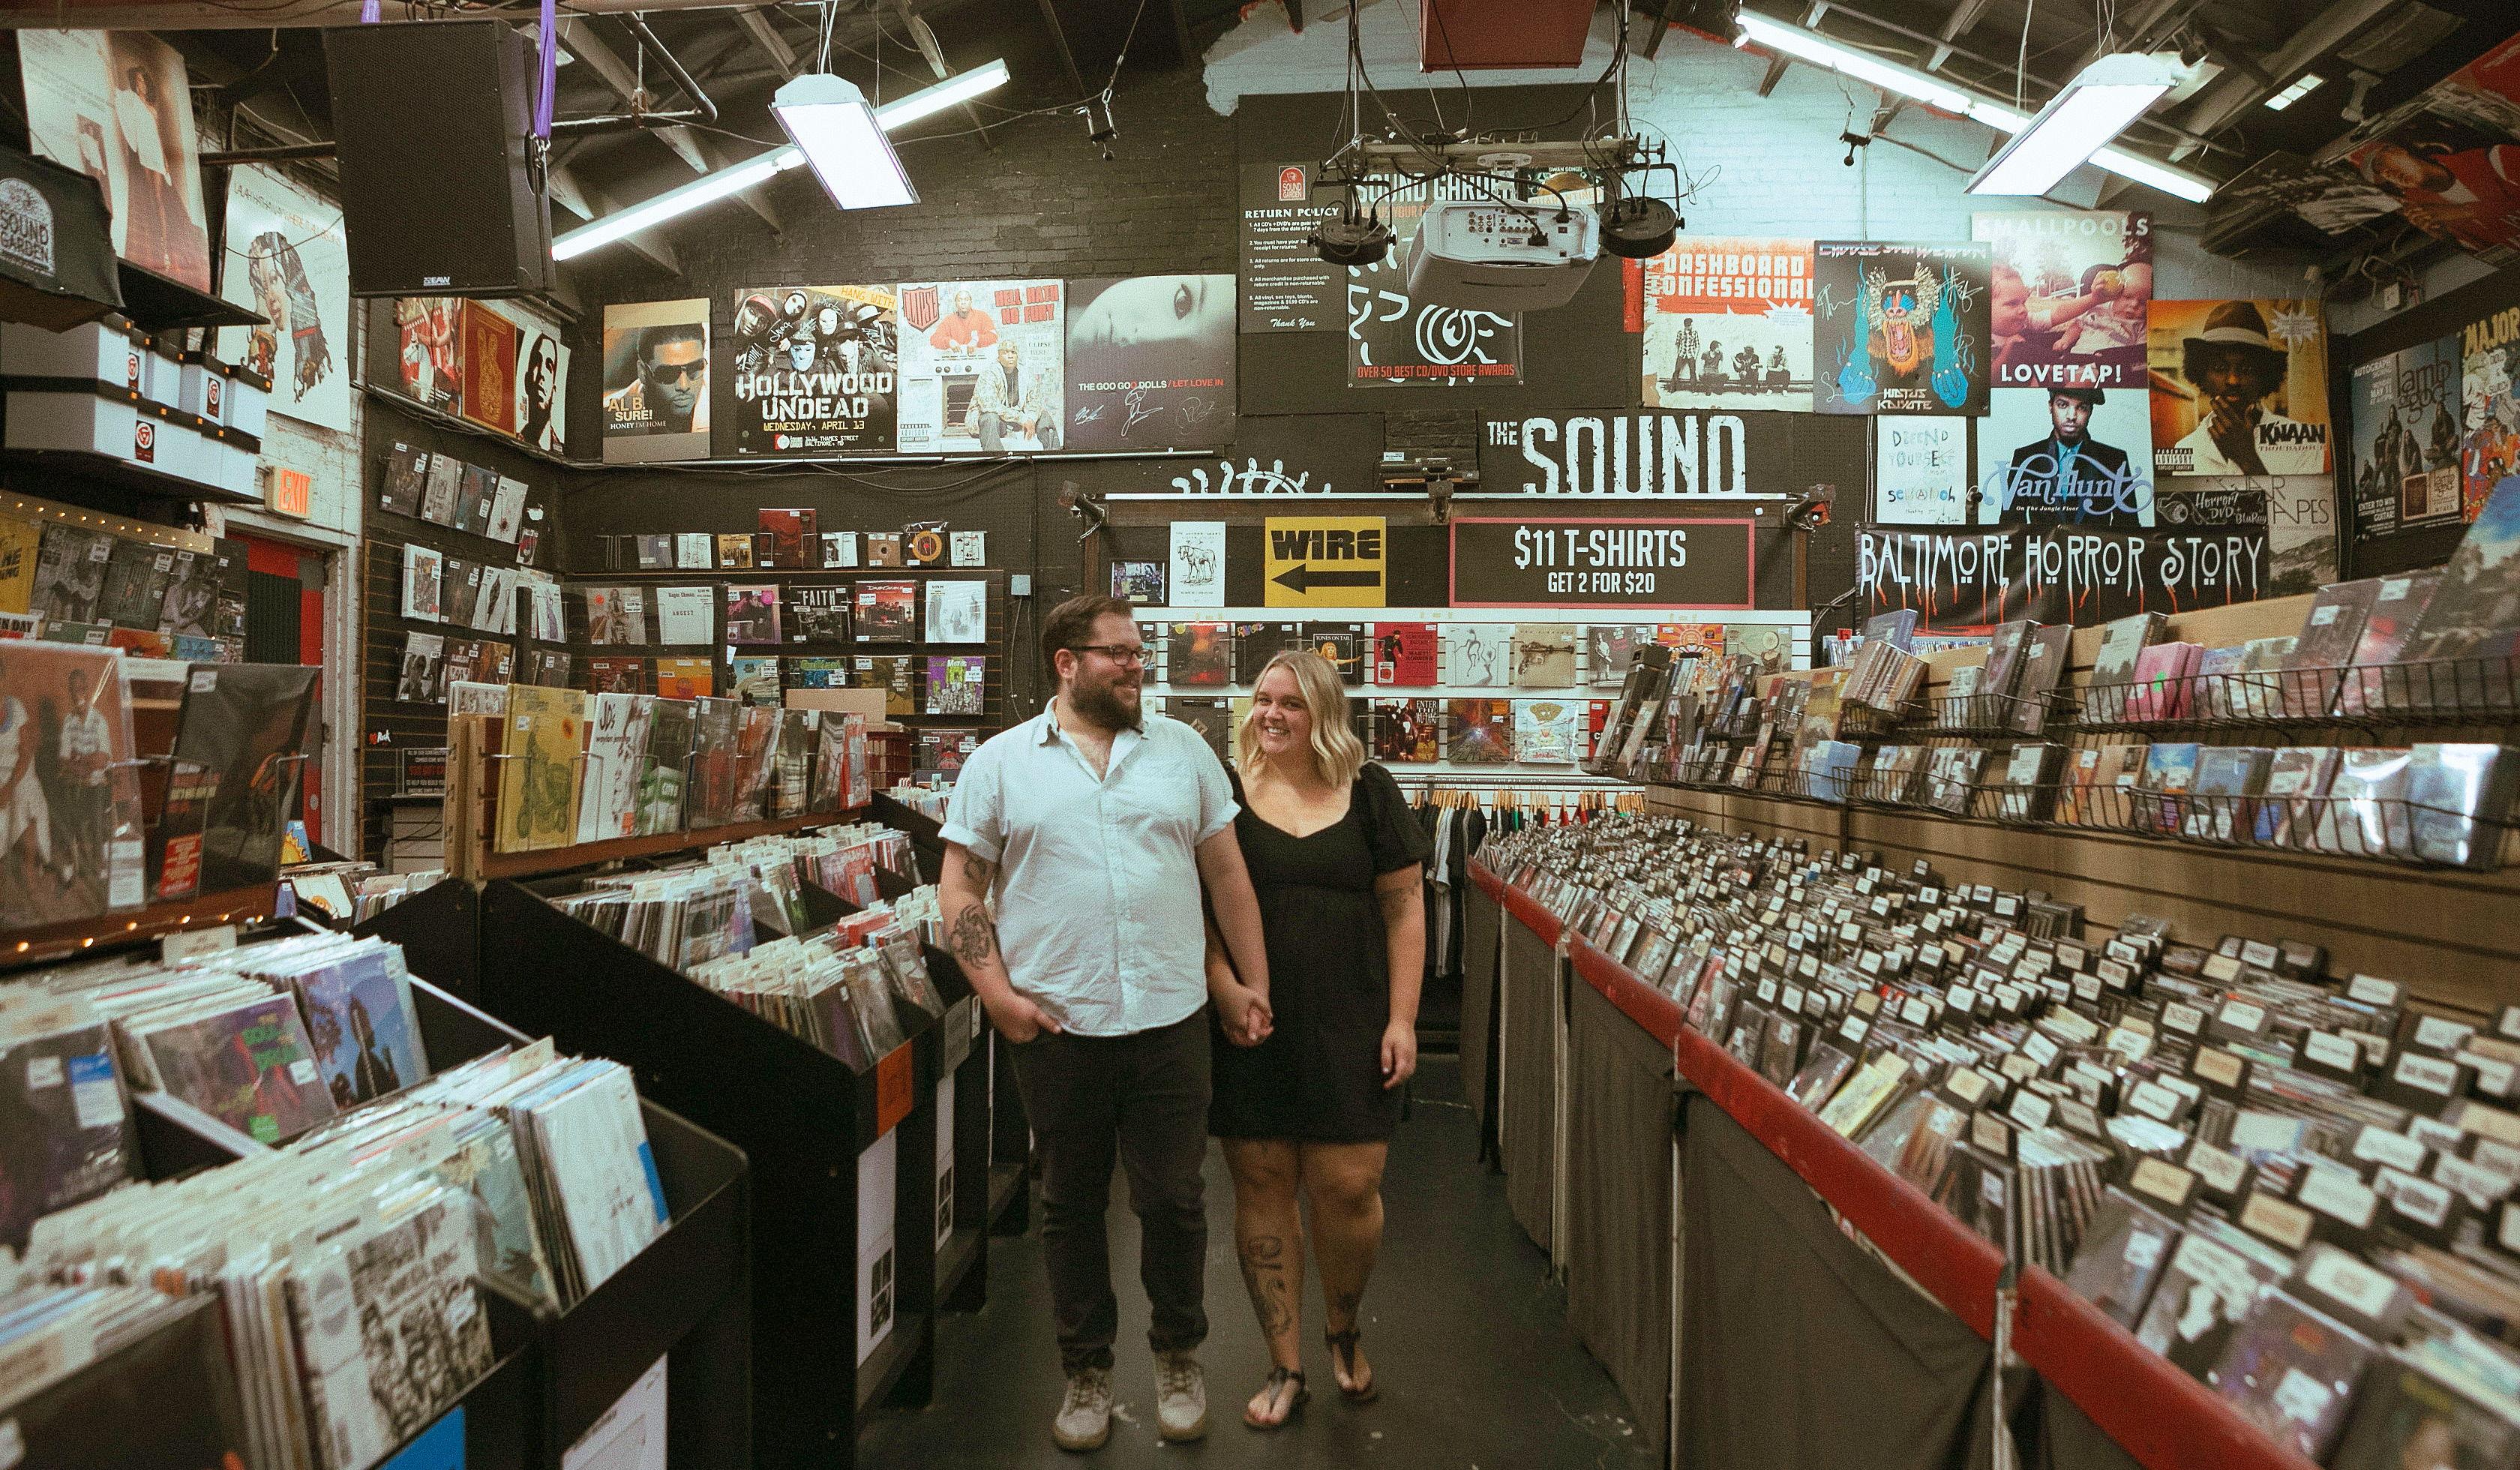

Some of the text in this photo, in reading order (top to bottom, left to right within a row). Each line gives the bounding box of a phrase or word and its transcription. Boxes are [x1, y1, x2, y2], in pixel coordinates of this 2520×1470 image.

[1282, 182, 1302, 191] SOUND
[1245, 208, 1339, 219] RETURN POLICY
[1663, 252, 1804, 277] DASHBOARD
[840, 286, 896, 308] HANG WITH
[994, 288, 1022, 308] HELL
[1024, 303, 1054, 323] FURY
[1270, 317, 1316, 328] Thank You
[1358, 364, 1380, 378] OVER
[1381, 365, 1392, 378] 50
[1394, 364, 1414, 377] BEST
[1450, 364, 1476, 376] STORE
[1478, 363, 1515, 376] AWARDS
[2000, 363, 2122, 384] LOVETAP!
[735, 371, 893, 402] HOLLYWOOD
[1078, 383, 1096, 392] THE
[1118, 382, 1138, 390] GOO
[1138, 381, 1167, 389] DOLLS
[1173, 380, 1190, 388] LET
[608, 396, 645, 412] AL B.
[762, 395, 869, 422] UNDEAD
[615, 410, 653, 422] SURE!
[764, 420, 865, 432] WEDNESDAY, APRIL 13
[1486, 415, 1747, 494] THE SOUND
[278, 468, 310, 515] EXIT
[1982, 453, 2155, 516] Van Hunt
[2210, 506, 2234, 519] DVD
[1270, 529, 1382, 561] WIRE
[1514, 525, 1688, 570] $11 T-SHIRTS
[1860, 534, 2264, 594] BALTIMORE HORROR STORY
[1548, 570, 1656, 595] GET 2 FOR $20
[802, 590, 836, 606] FAITH
[1416, 700, 1437, 709] ENTER
